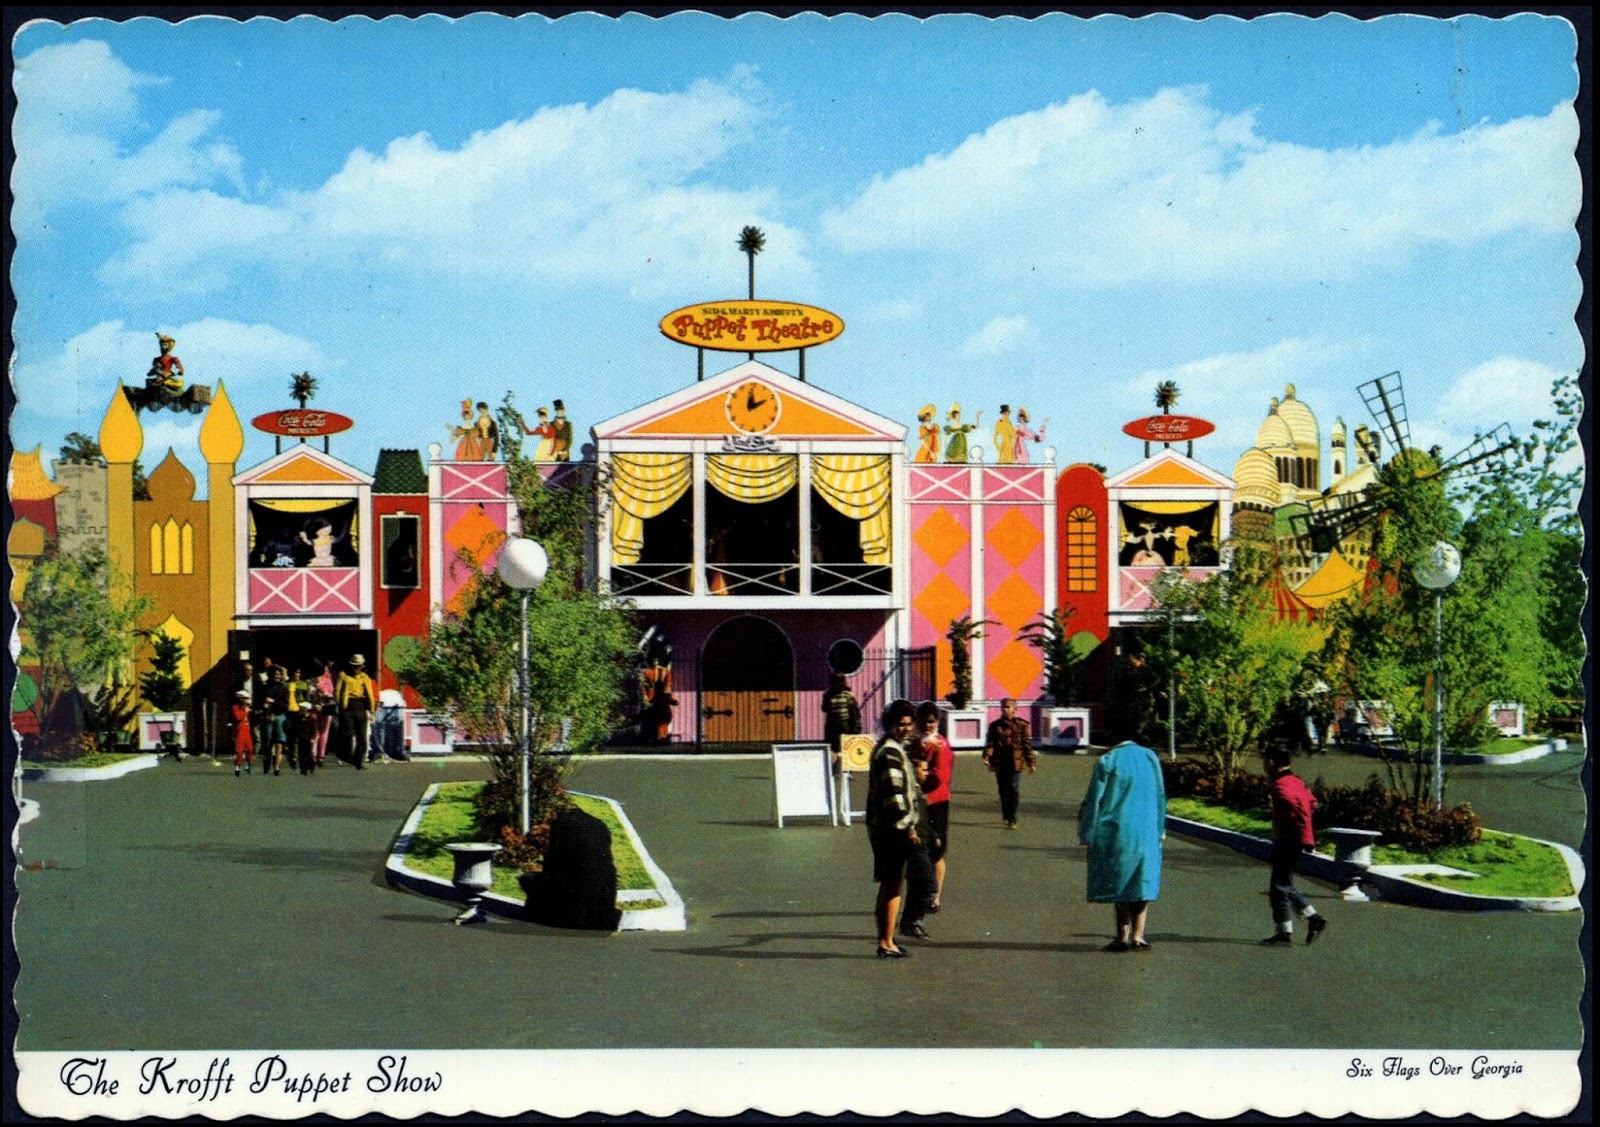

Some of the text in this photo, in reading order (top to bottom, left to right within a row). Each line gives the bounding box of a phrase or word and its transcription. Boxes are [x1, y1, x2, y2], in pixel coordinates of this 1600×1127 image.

[729, 308, 760, 316] MARTY
[672, 314, 835, 344] Puppet Theatre
